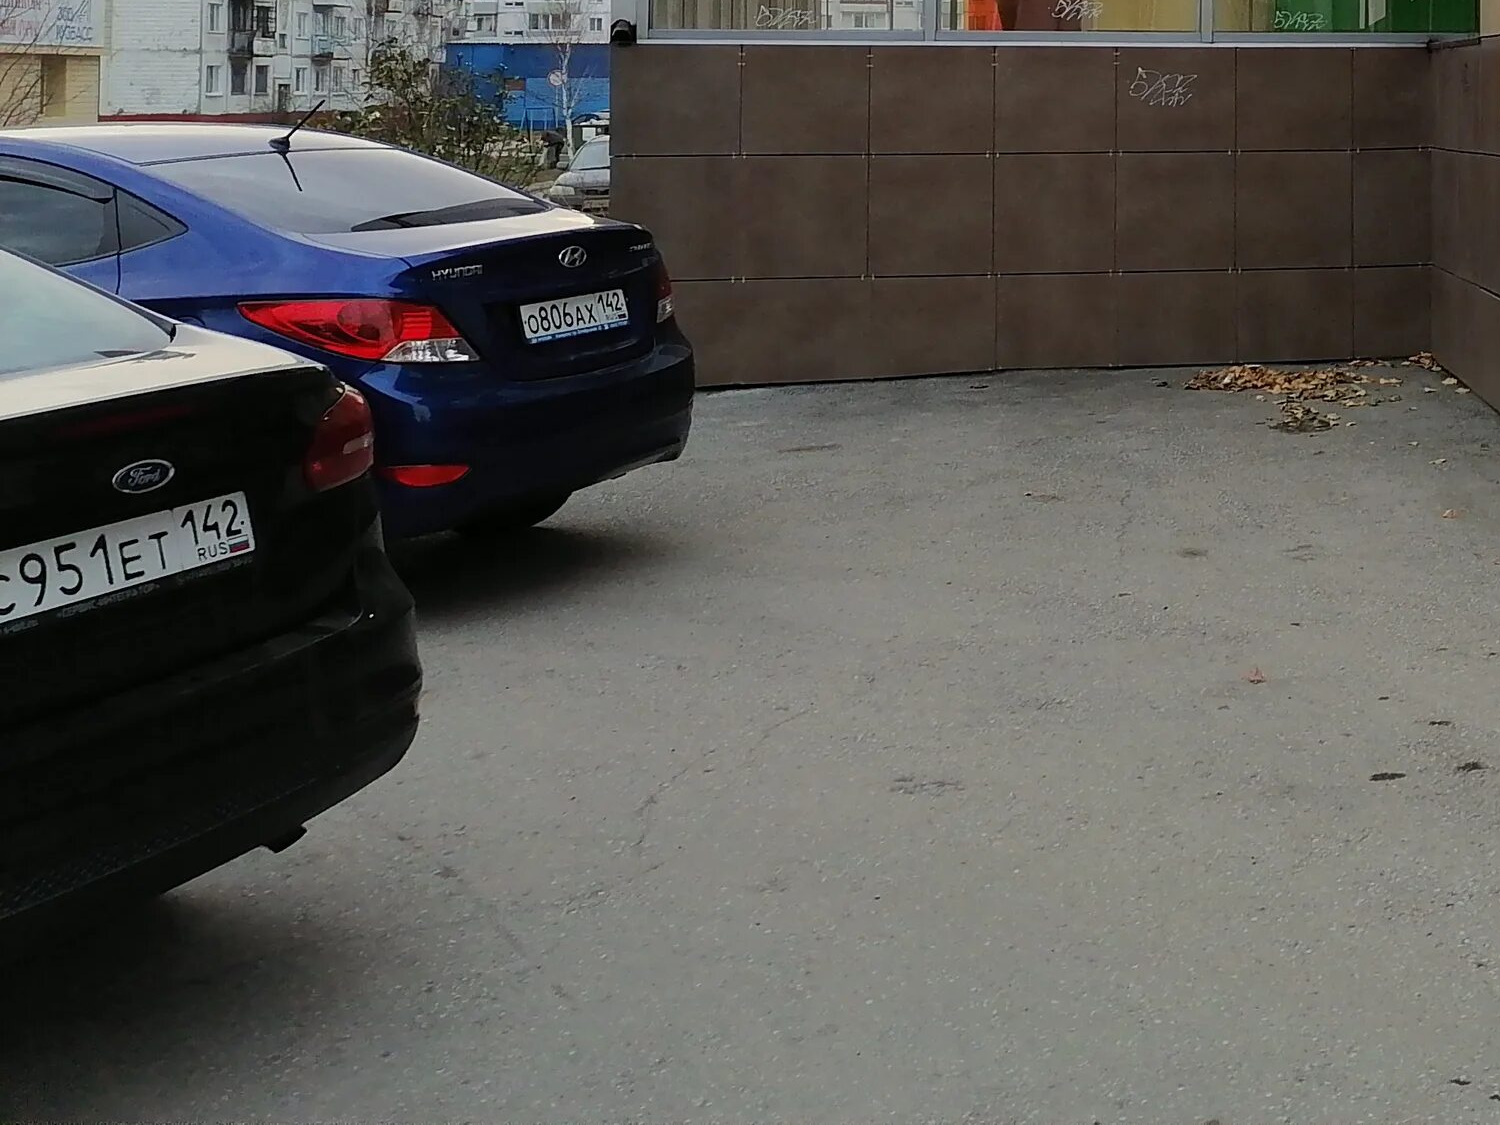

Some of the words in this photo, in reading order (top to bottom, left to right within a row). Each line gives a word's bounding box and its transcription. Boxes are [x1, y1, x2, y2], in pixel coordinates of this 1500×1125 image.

[431, 264, 483, 281] HYUNDAI
[597, 292, 623, 314] 142
[128, 466, 161, 487] Ford
[180, 499, 243, 546] 142
[197, 542, 231, 562] RUS
